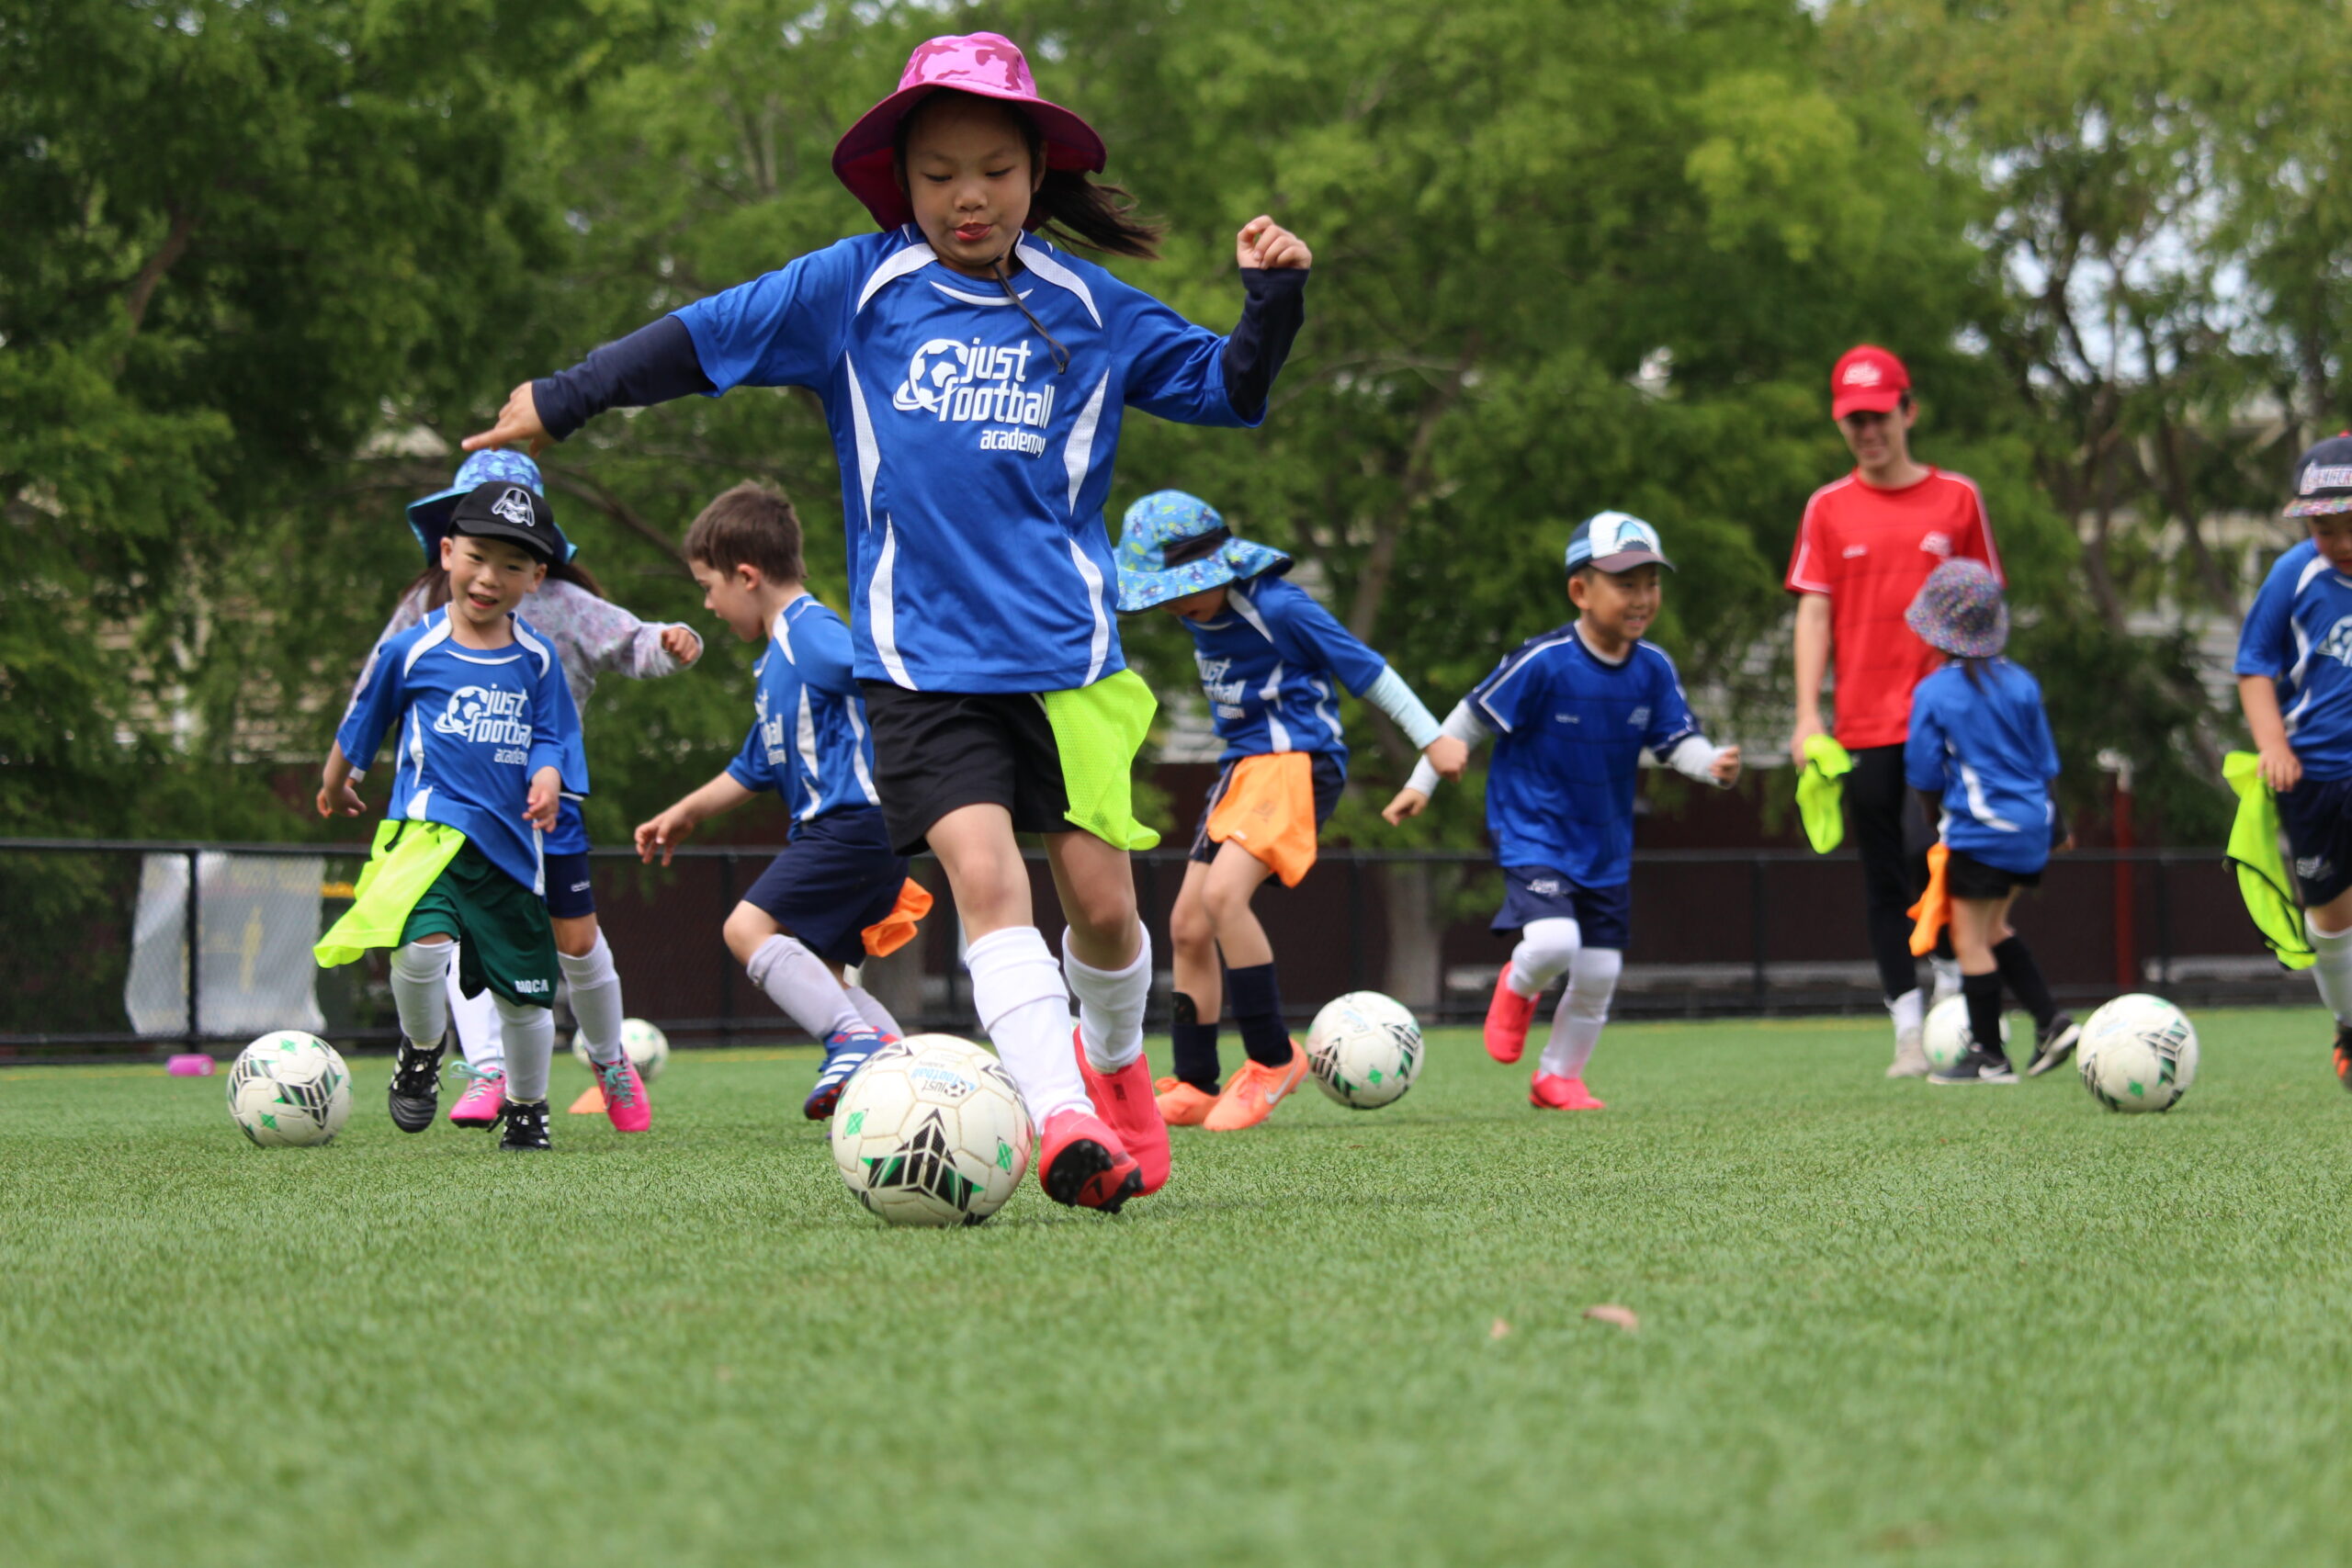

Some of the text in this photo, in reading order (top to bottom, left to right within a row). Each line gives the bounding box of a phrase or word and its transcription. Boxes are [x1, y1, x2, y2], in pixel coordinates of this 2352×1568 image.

[959, 337, 1032, 383] just
[939, 377, 1056, 430] football
[979, 427, 1046, 458] academy
[482, 682, 529, 717] just
[467, 712, 532, 750] footba
